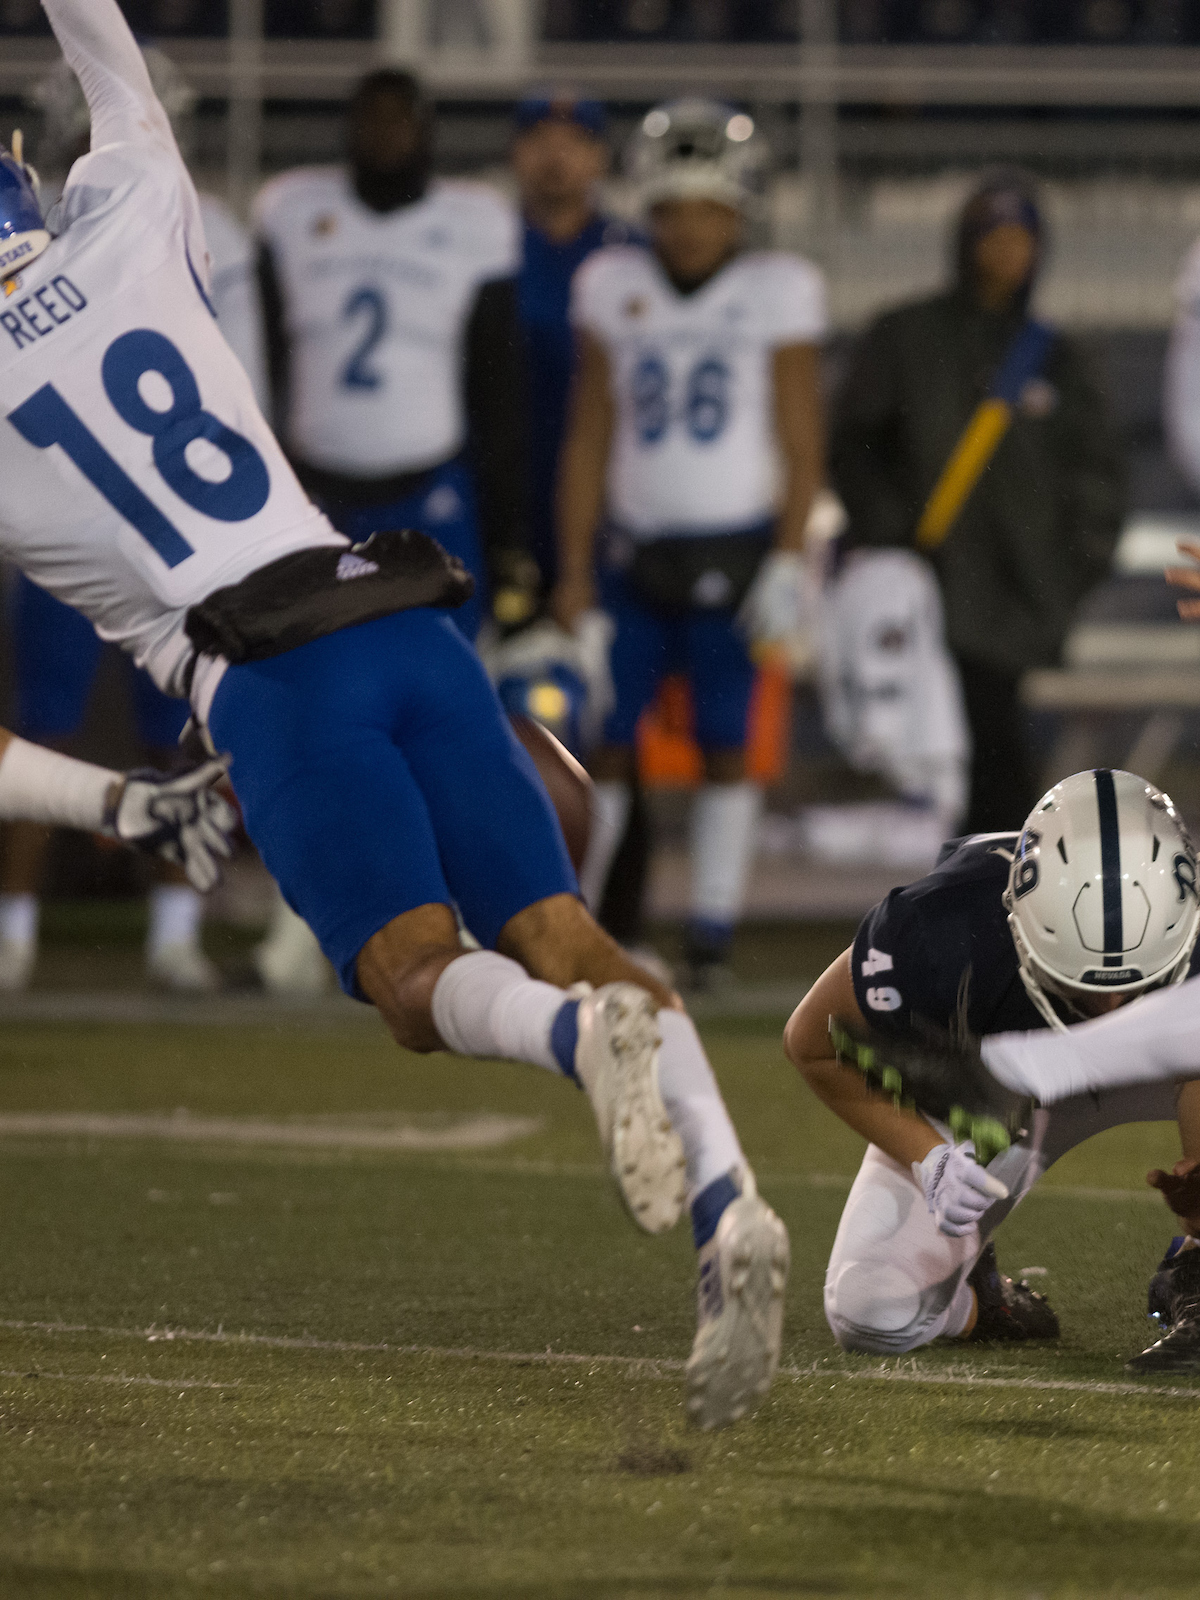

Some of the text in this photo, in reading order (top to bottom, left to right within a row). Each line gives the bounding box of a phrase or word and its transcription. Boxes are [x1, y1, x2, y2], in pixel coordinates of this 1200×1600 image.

[0, 241, 32, 267] STATE
[0, 274, 88, 349] REED
[338, 286, 392, 393] 2
[7, 329, 271, 569] 18
[861, 947, 902, 1011] 49
